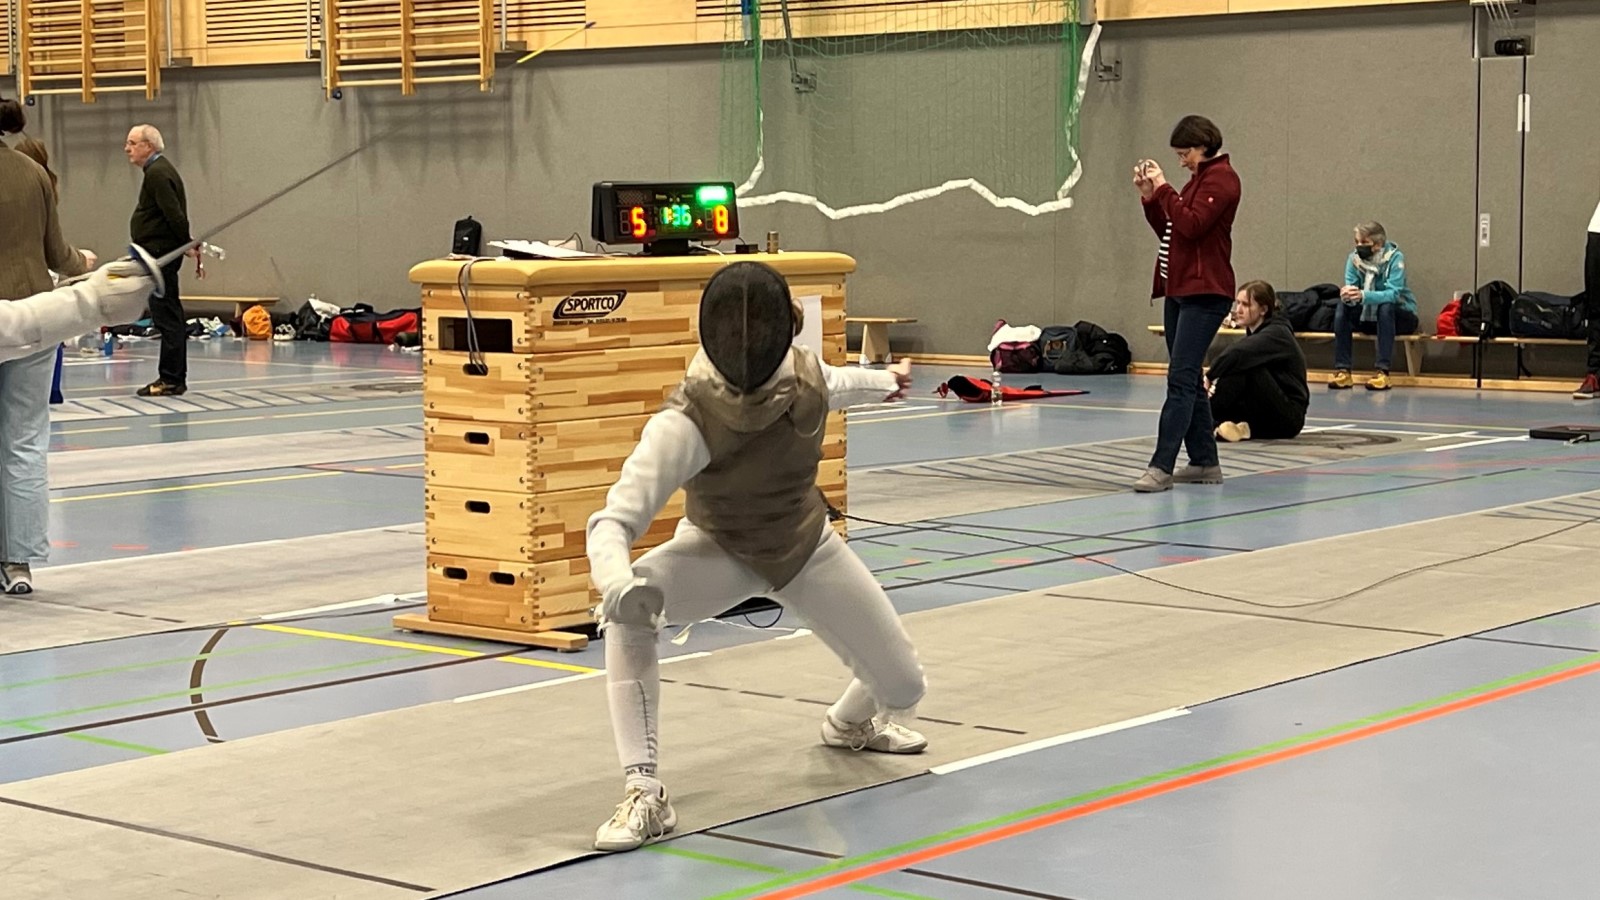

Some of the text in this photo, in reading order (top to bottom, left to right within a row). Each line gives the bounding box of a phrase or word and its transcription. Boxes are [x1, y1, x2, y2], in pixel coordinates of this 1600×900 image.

[631, 206, 647, 237] 5
[713, 205, 729, 235] 8
[564, 296, 615, 312] SPORTCO
